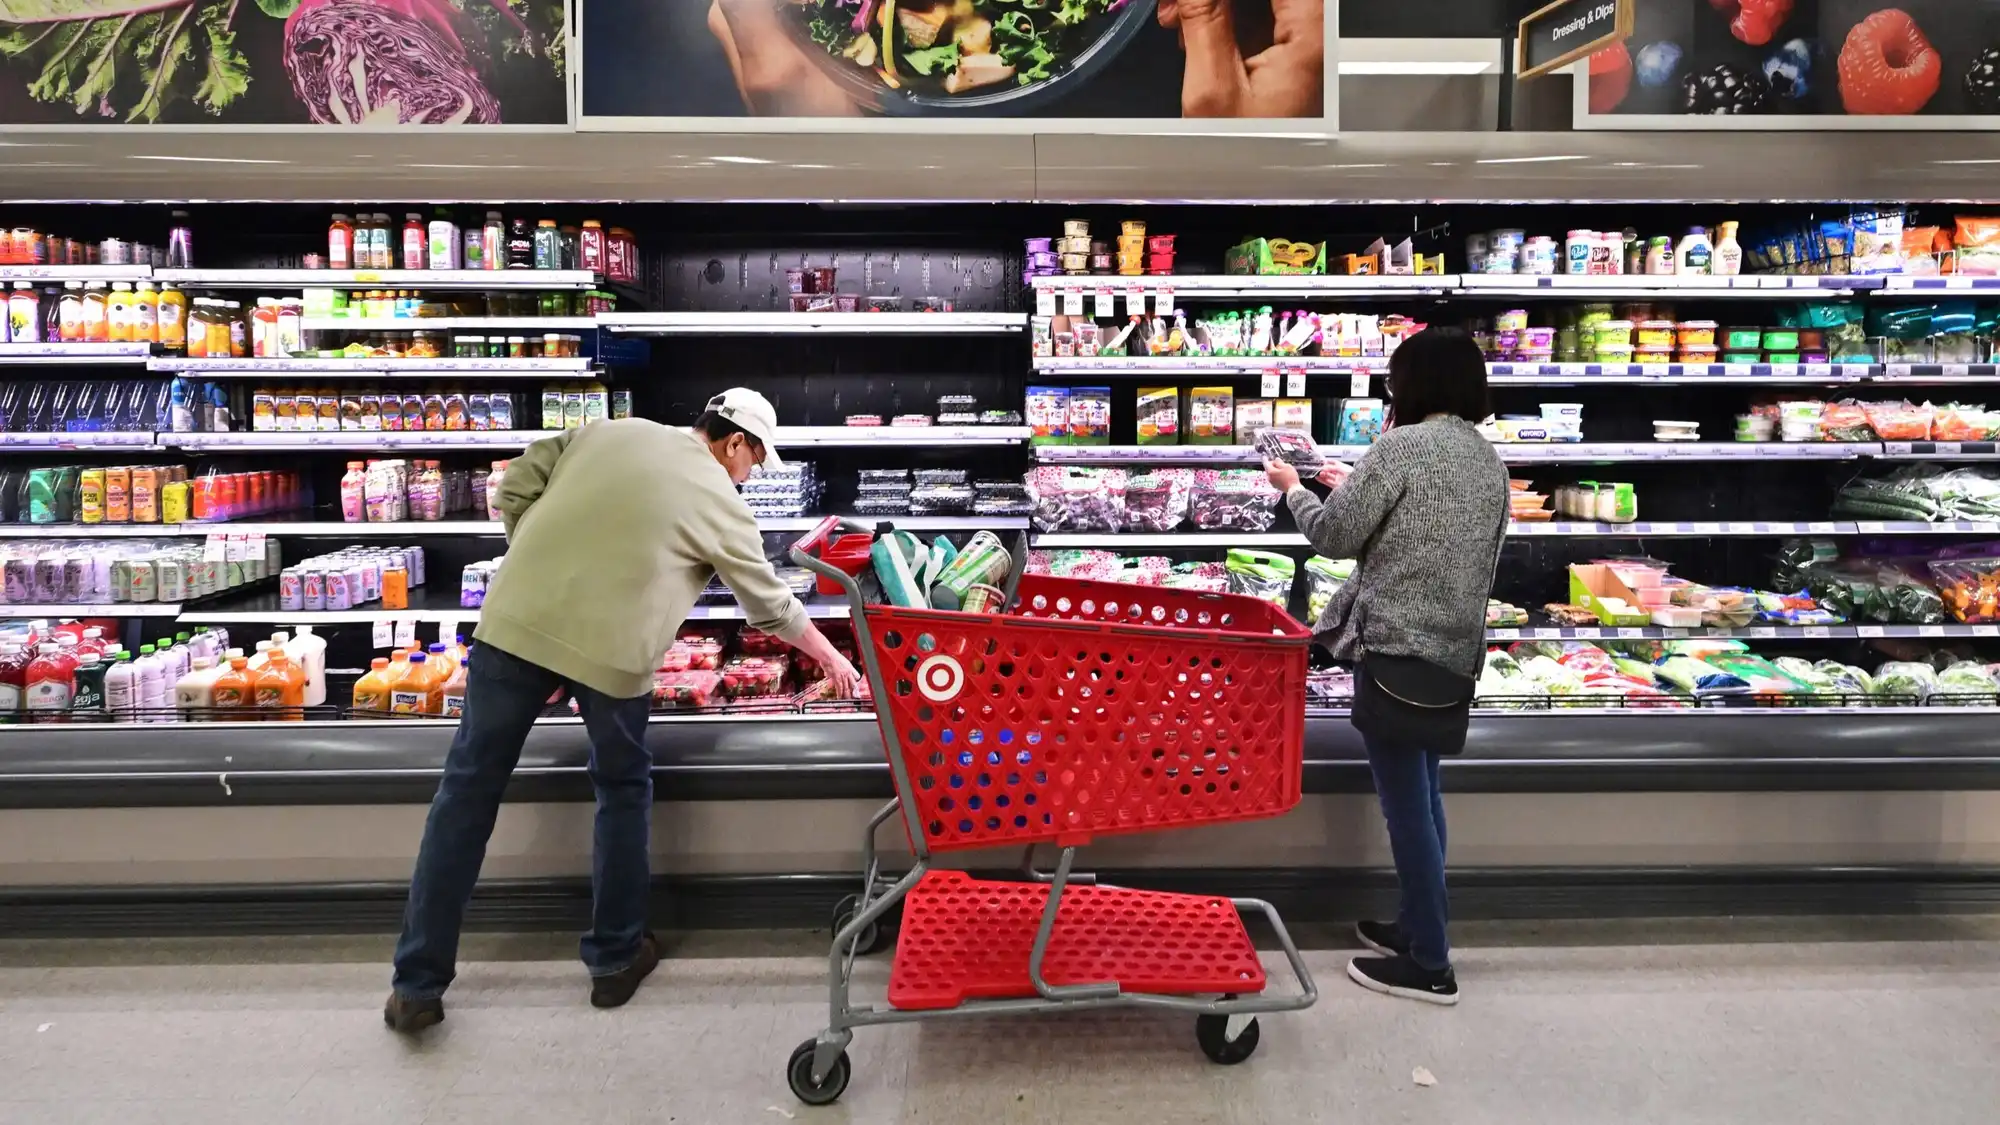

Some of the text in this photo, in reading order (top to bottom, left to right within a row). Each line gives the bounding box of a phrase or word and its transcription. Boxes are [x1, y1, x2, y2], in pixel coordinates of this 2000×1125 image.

[1552, 2, 1615, 41] Dressing & Dips
